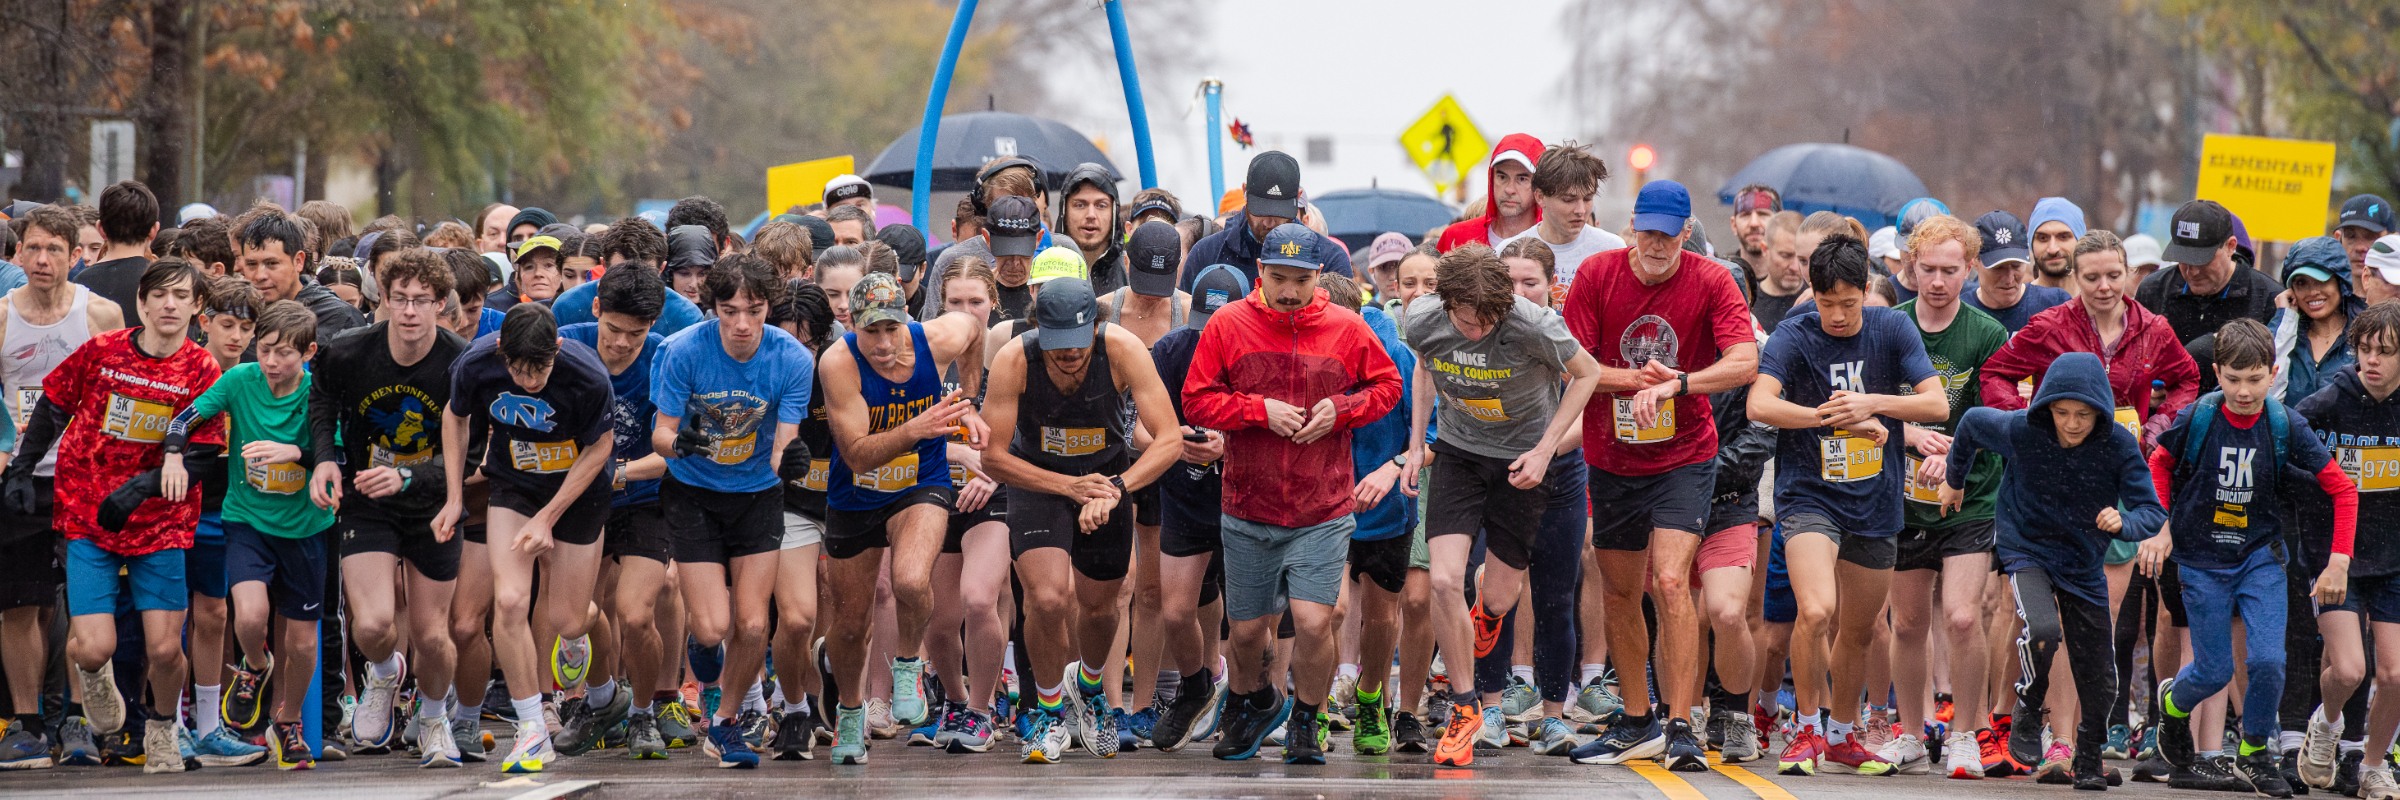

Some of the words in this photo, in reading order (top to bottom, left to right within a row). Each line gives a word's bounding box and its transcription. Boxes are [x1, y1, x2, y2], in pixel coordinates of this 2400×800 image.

[2208, 154, 2327, 178] ELEMENTARY
[2222, 174, 2304, 195] FAMILIES
[1452, 349, 1487, 367] NIKE
[1463, 366, 1512, 380] COUNTRY
[1829, 360, 1866, 394] 5K
[114, 371, 150, 387] UNDER
[151, 379, 190, 396] ARMOUR
[24, 390, 38, 405] 5K
[371, 385, 394, 402] HEN
[692, 390, 729, 400] CROSS
[115, 397, 129, 412] 5K
[1619, 400, 1632, 414] 5K
[133, 411, 170, 433] 788
[1049, 427, 1062, 438] 5K
[517, 441, 532, 452] 5K
[1068, 434, 1104, 449] 358
[1829, 440, 1842, 454] 5K
[377, 449, 390, 460] 5K
[539, 446, 575, 461] 971
[1848, 446, 1882, 465] 1310
[2218, 446, 2257, 488] 5K
[2363, 459, 2400, 479] 979
[2215, 488, 2254, 504] EDUCATION
